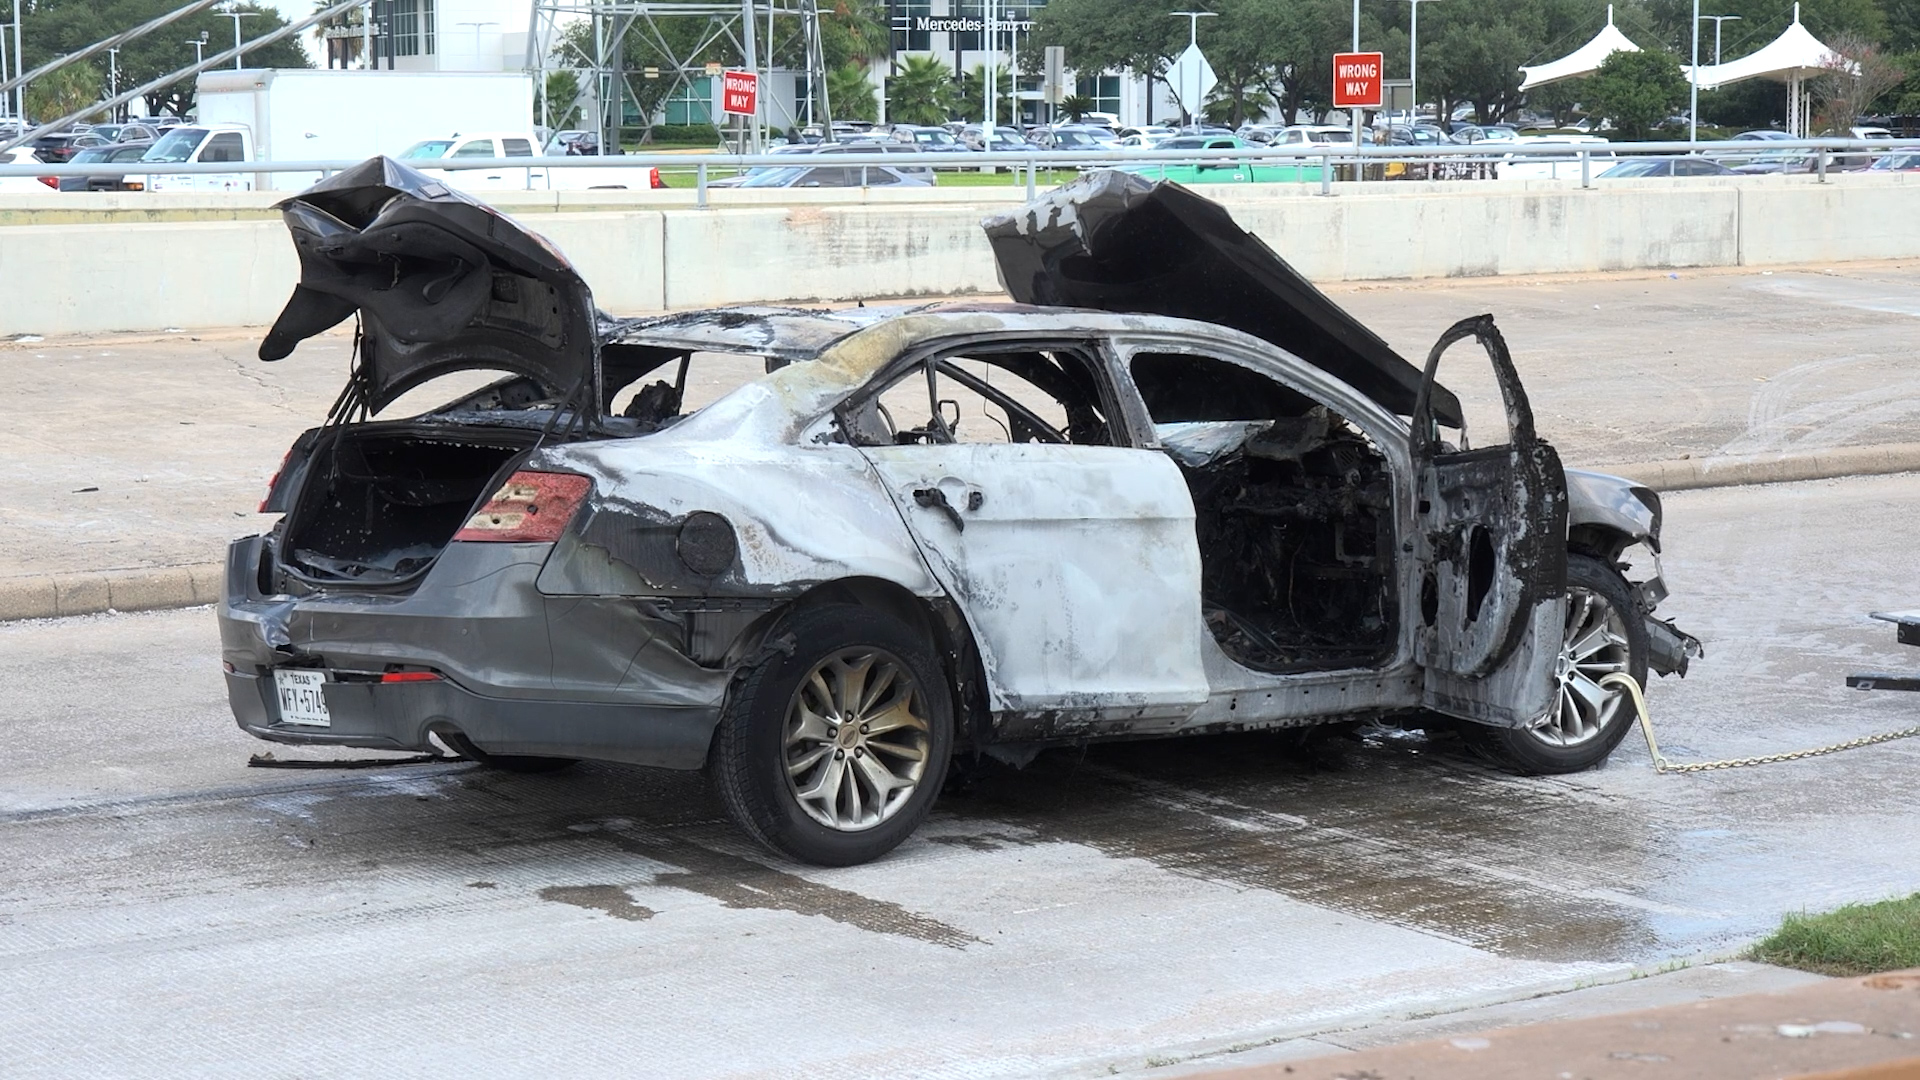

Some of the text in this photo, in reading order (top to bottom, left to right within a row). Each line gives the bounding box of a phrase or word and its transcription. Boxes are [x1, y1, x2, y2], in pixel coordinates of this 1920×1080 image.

[1339, 63, 1377, 78] WRONG
[726, 77, 756, 94] WRONG
[1345, 81, 1369, 96] WAY
[730, 94, 749, 109] WAY
[290, 672, 311, 686] TEXAS
